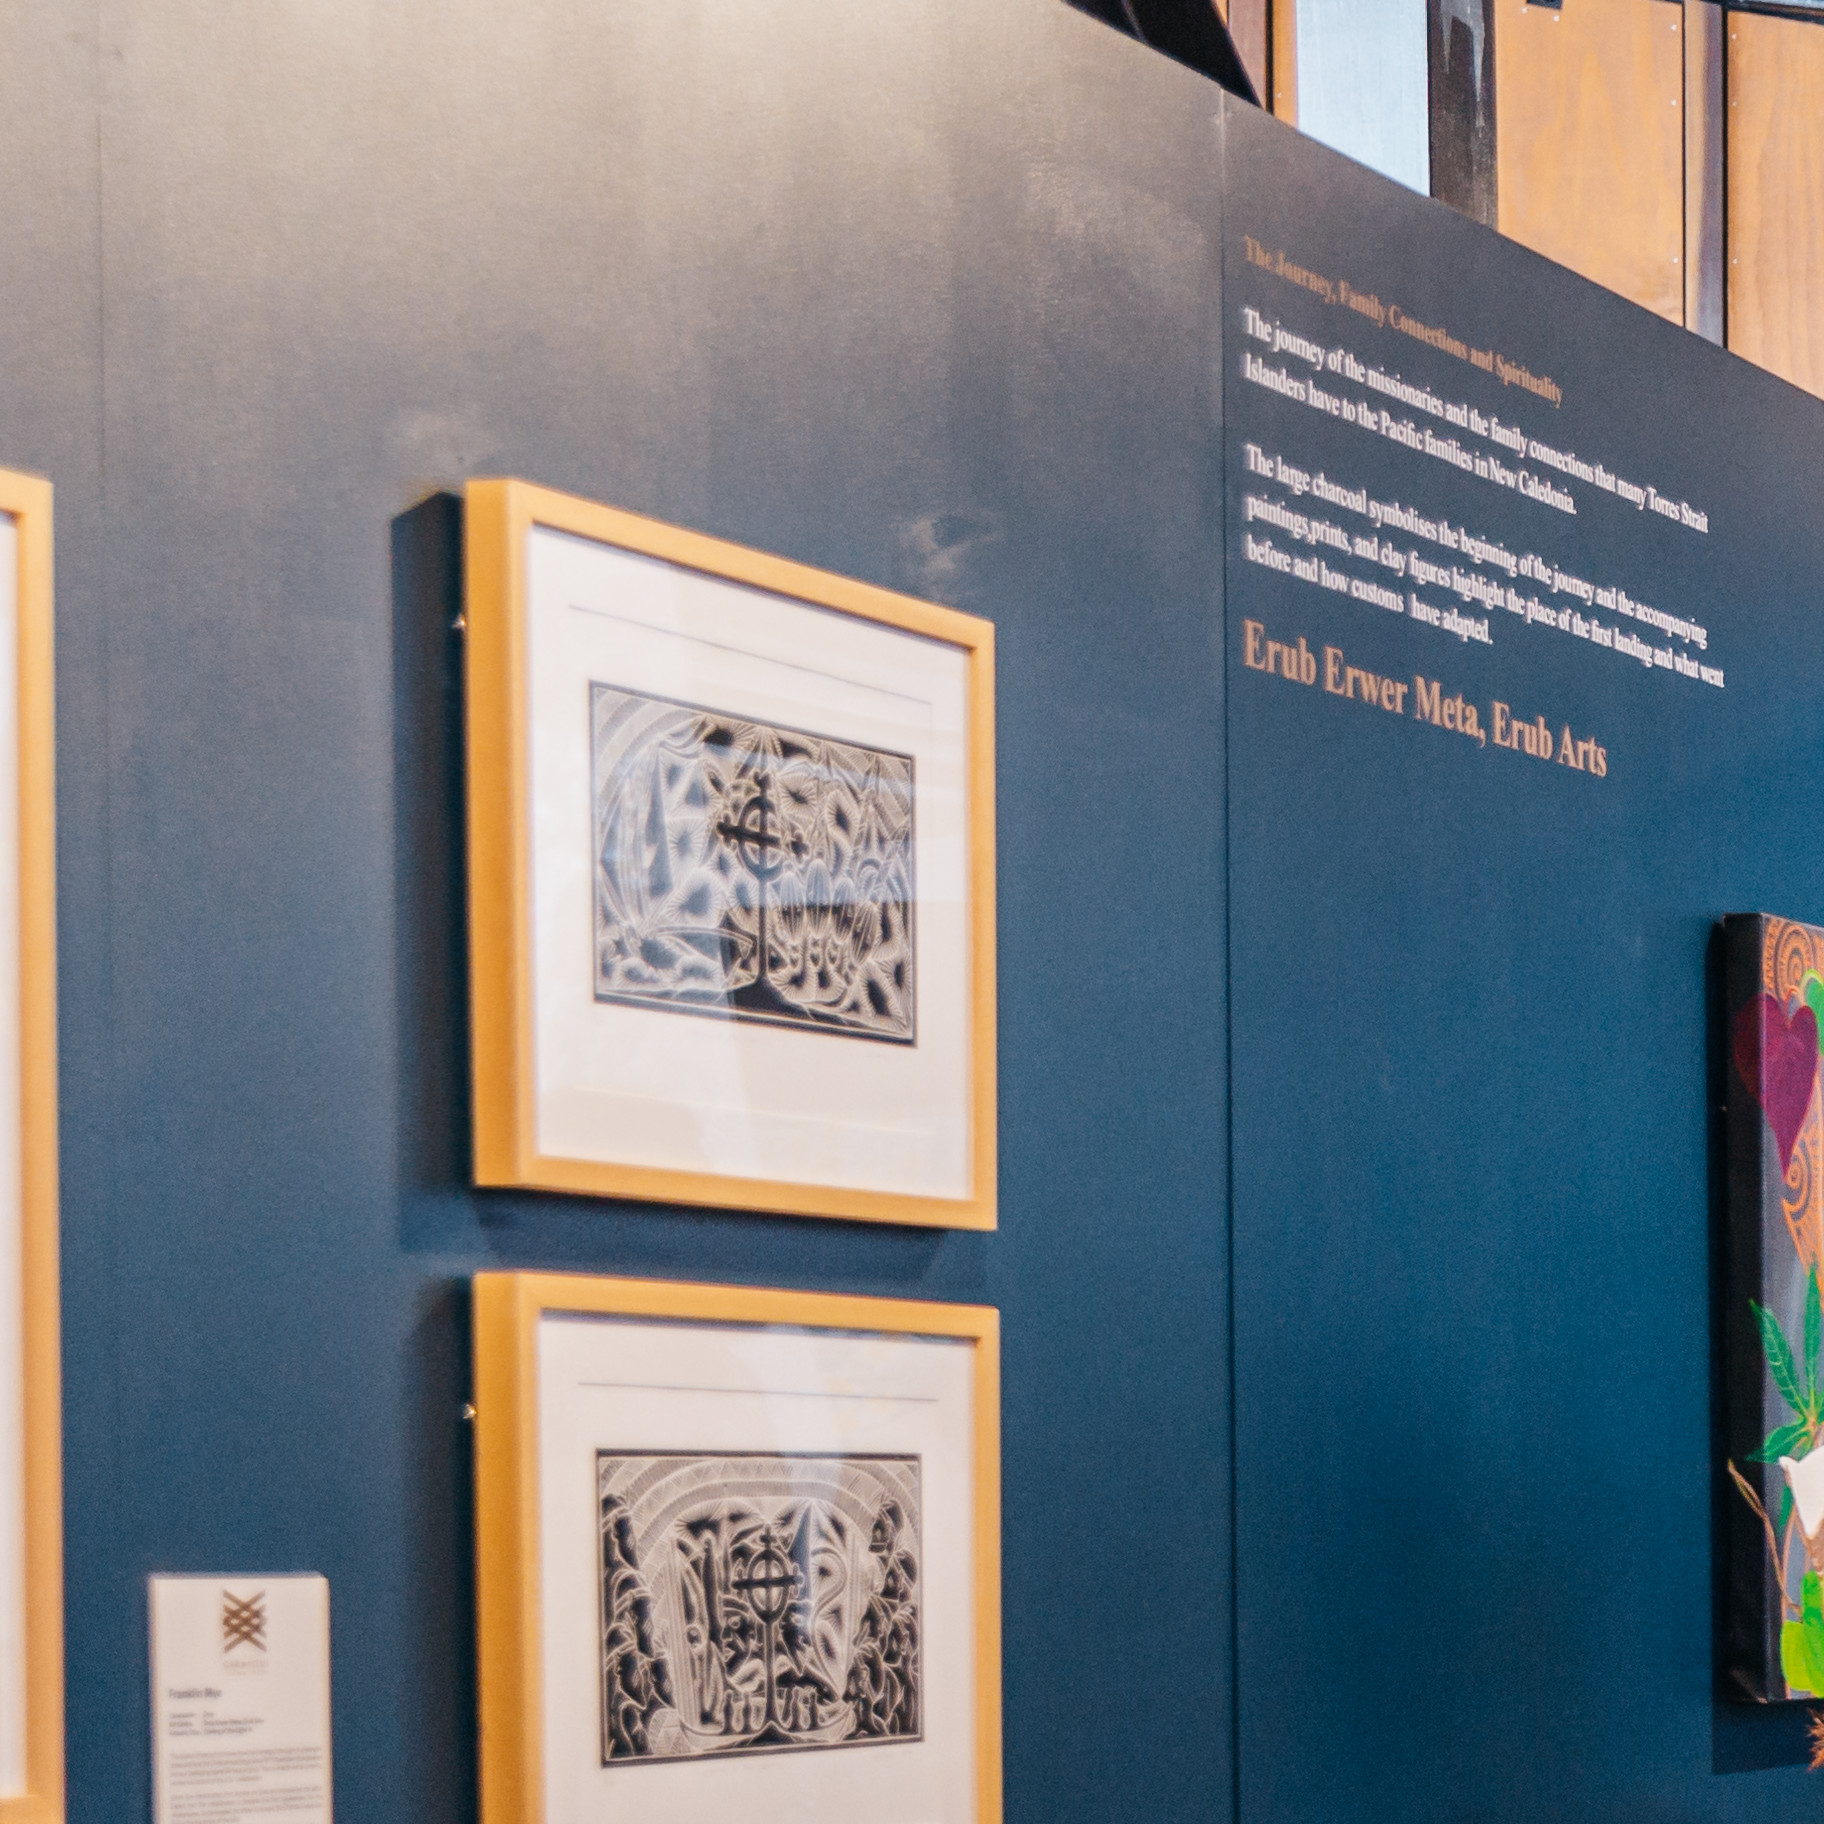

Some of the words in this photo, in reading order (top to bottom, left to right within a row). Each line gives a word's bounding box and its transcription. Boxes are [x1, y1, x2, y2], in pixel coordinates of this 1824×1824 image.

[1244, 234, 1273, 272] The
[1276, 249, 1337, 305] Journey,
[1338, 279, 1387, 329] Family
[1389, 304, 1468, 361] Connections
[1470, 348, 1494, 373] and
[1495, 353, 1564, 409] Spirituality
[1244, 307, 1272, 342] The
[1273, 320, 1326, 371] journey
[1327, 348, 1345, 373] of
[1345, 354, 1366, 384] the
[1367, 365, 1444, 418] missionaries
[1446, 403, 1468, 428] and
[1470, 408, 1489, 437] the
[1490, 417, 1528, 459] family
[1530, 440, 1595, 483] connections
[1595, 464, 1616, 492] that
[1617, 479, 1647, 511] many
[1648, 487, 1681, 521] Torres
[1681, 502, 1709, 534] Strait
[1245, 353, 1306, 401] Islanders
[1308, 379, 1340, 416] have
[1343, 399, 1356, 422] to
[1357, 401, 1379, 431] the
[1380, 410, 1423, 451] Pacific
[1424, 430, 1473, 472] families
[1475, 451, 1489, 479] in
[1489, 457, 1518, 489] New
[1518, 470, 1577, 515] Caledonia.
[1246, 443, 1274, 478] The
[1276, 455, 1310, 496] large
[1312, 472, 1367, 514] charcoal
[1369, 500, 1437, 541] symbolises
[1438, 521, 1459, 549] the
[1459, 527, 1517, 578] beginning
[1518, 553, 1535, 577] of
[1534, 557, 1552, 585] the
[1552, 564, 1594, 606] journey
[1596, 588, 1617, 611] and
[1617, 591, 1635, 617] the
[1635, 603, 1708, 650] accompanying
[1246, 534, 1291, 573] before
[1294, 557, 1319, 583] and
[1320, 561, 1350, 593] how
[1351, 579, 1405, 613] customs
[1409, 592, 1441, 627] have
[1442, 607, 1494, 646] adapted.
[1354, 537, 1379, 561] and
[1380, 542, 1407, 577] clay
[1409, 551, 1451, 585] figures
[1451, 566, 1505, 610] highlight
[1505, 588, 1526, 615] the
[1526, 597, 1557, 624] place
[1558, 607, 1572, 632] of
[1572, 613, 1590, 639] the
[1590, 620, 1613, 648] first
[1613, 627, 1653, 668] landing
[1654, 647, 1673, 670] and
[1674, 653, 1699, 679] what
[1700, 665, 1725, 689] went
[1243, 619, 1317, 686] Erub
[1325, 645, 1409, 715] Erwer
[1413, 675, 1486, 749] Meta,
[1492, 700, 1554, 761] Erub
[1557, 723, 1608, 778] Arts
